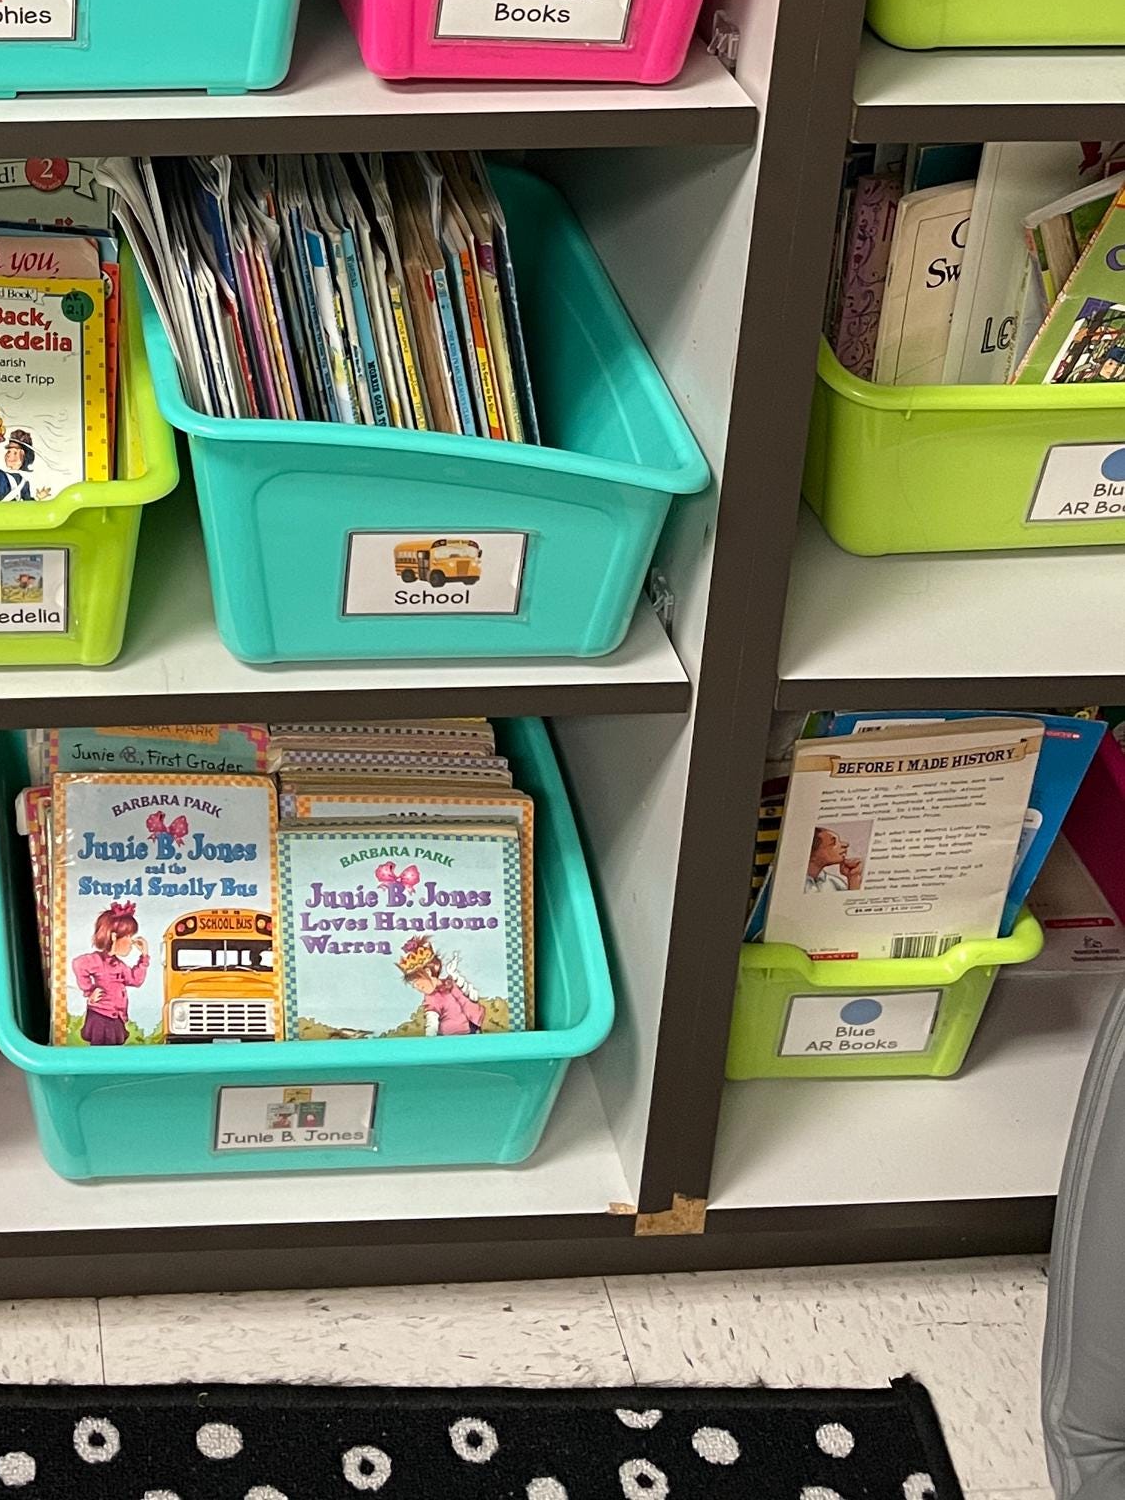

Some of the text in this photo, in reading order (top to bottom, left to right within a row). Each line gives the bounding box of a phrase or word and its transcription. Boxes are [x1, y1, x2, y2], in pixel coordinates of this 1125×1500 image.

[494, 3, 571, 23] Books
[40, 158, 54, 179] 2
[10, 251, 60, 276] you,
[346, 253, 359, 288] Wiseman
[7, 289, 32, 300] Book
[400, 335, 410, 353] APPLE
[26, 373, 55, 386] Tripp
[367, 360, 380, 392] MORRIS
[374, 394, 384, 414] GOES
[1093, 483, 1125, 497] Blu
[1057, 501, 1089, 515] AR
[394, 590, 469, 605] School
[72, 743, 115, 762] Junie
[146, 749, 182, 768] First
[186, 753, 244, 773] Grader
[837, 747, 1015, 774] BEFORE I MADE HISTORY
[112, 794, 223, 818] BARBARA PARK
[77, 831, 258, 861] Junie B. Jones
[339, 846, 456, 869] BARBARA PARK
[145, 862, 187, 875] and the
[78, 875, 258, 900] Stupid Smelly Bus
[305, 881, 492, 909] Junie B. Jones
[198, 917, 253, 931] SCHOOL BUS
[299, 911, 499, 932] Loves Handsome
[300, 935, 393, 955] Warren
[835, 1026, 876, 1038] Blue
[805, 1038, 898, 1052] AR Books
[221, 1129, 364, 1145] Junie B. Jones
